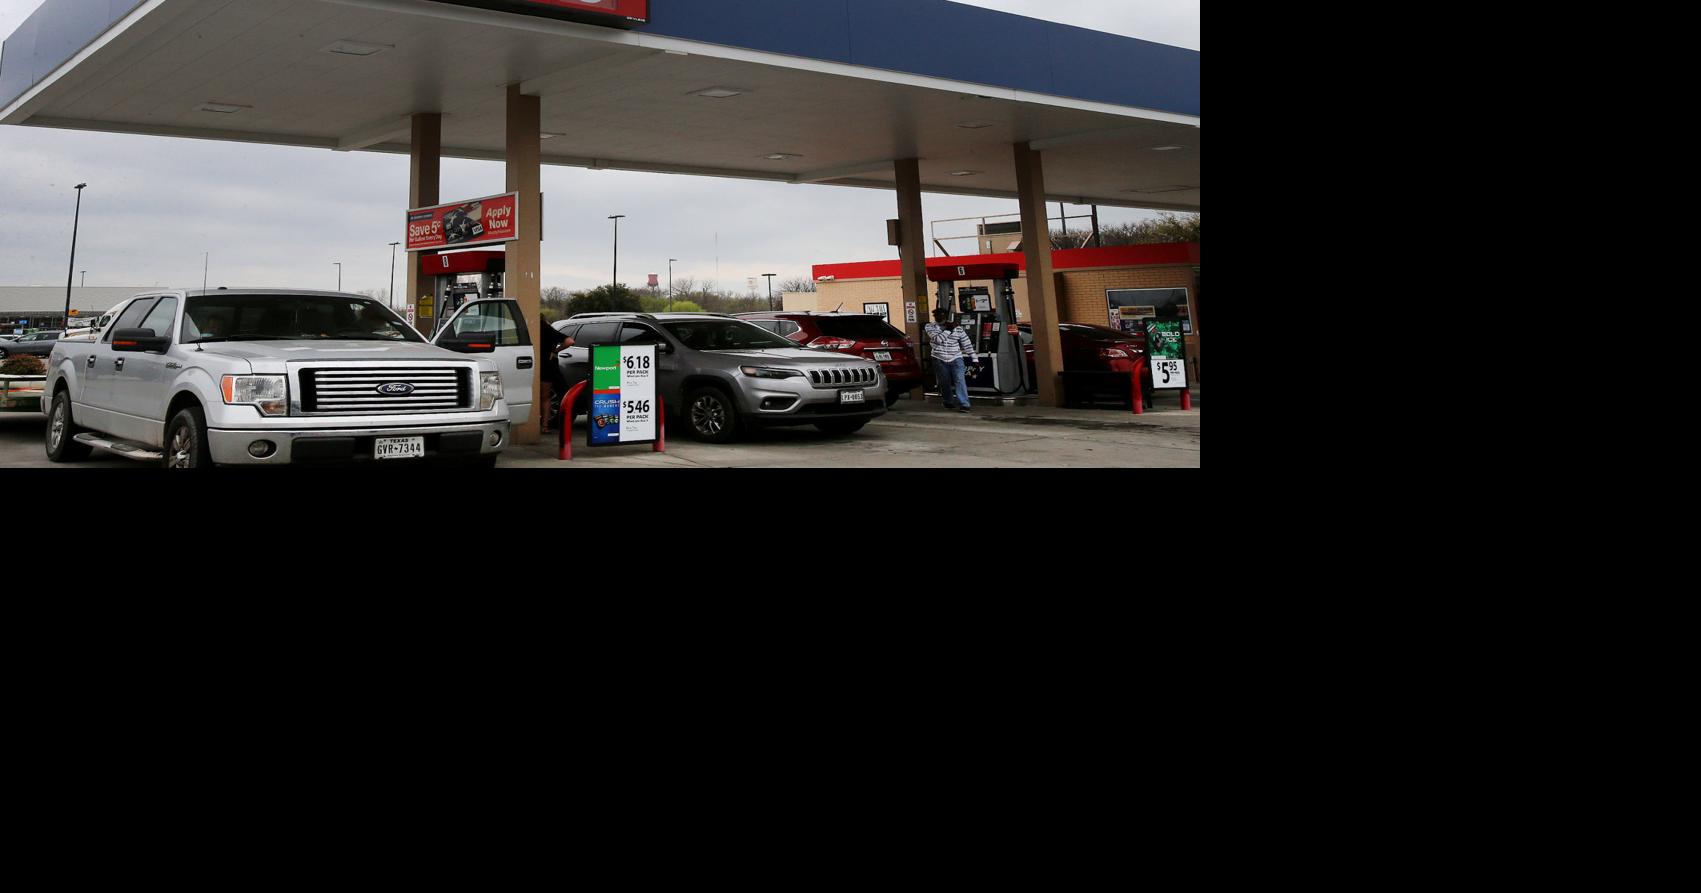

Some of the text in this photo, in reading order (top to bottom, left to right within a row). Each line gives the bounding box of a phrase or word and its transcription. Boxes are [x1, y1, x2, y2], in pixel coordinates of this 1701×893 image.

[486, 206, 512, 218] Apply
[488, 219, 509, 229] Now
[409, 224, 431, 237] Save
[386, 384, 406, 392] Ford
